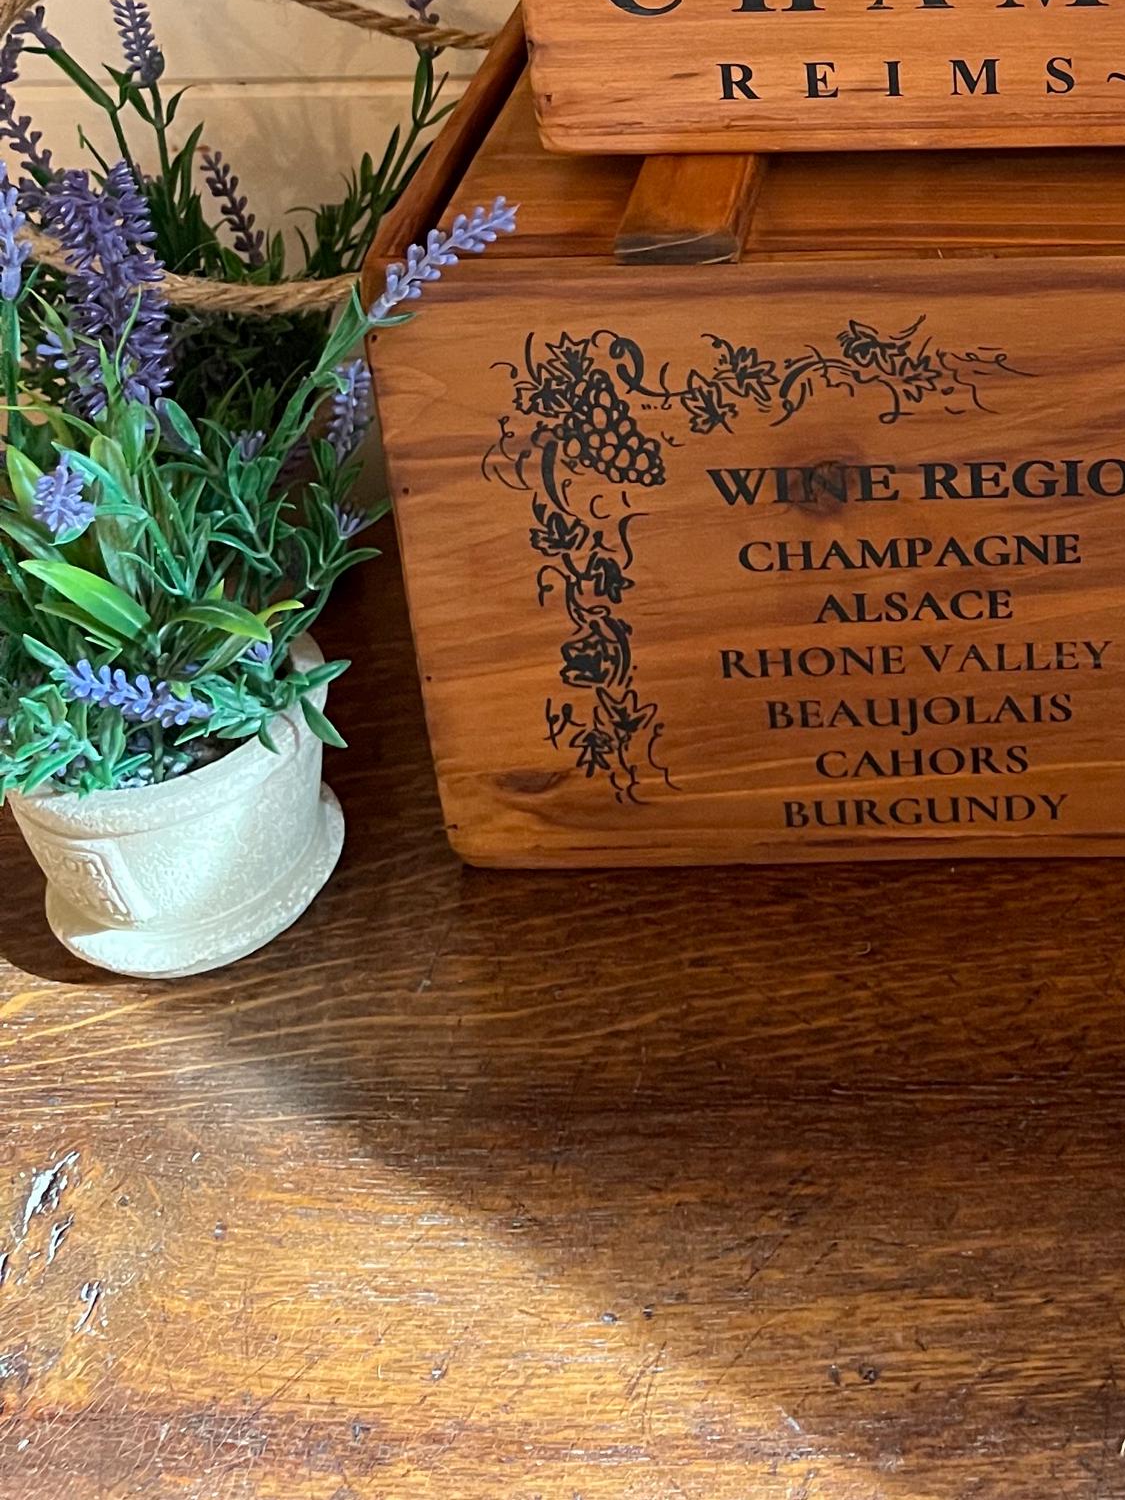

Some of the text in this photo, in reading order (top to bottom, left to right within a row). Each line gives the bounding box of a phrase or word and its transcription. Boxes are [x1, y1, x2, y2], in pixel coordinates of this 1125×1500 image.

[706, 461, 900, 506] WINE
[737, 533, 1082, 573] CHAMPAGNE
[812, 588, 1014, 624] ALSACE
[718, 640, 1113, 680] RHONE VALLEY
[766, 692, 1074, 737] BEAUJOLAIS
[815, 745, 1029, 780] CAHORS
[783, 793, 1069, 829] BURGUNDY
